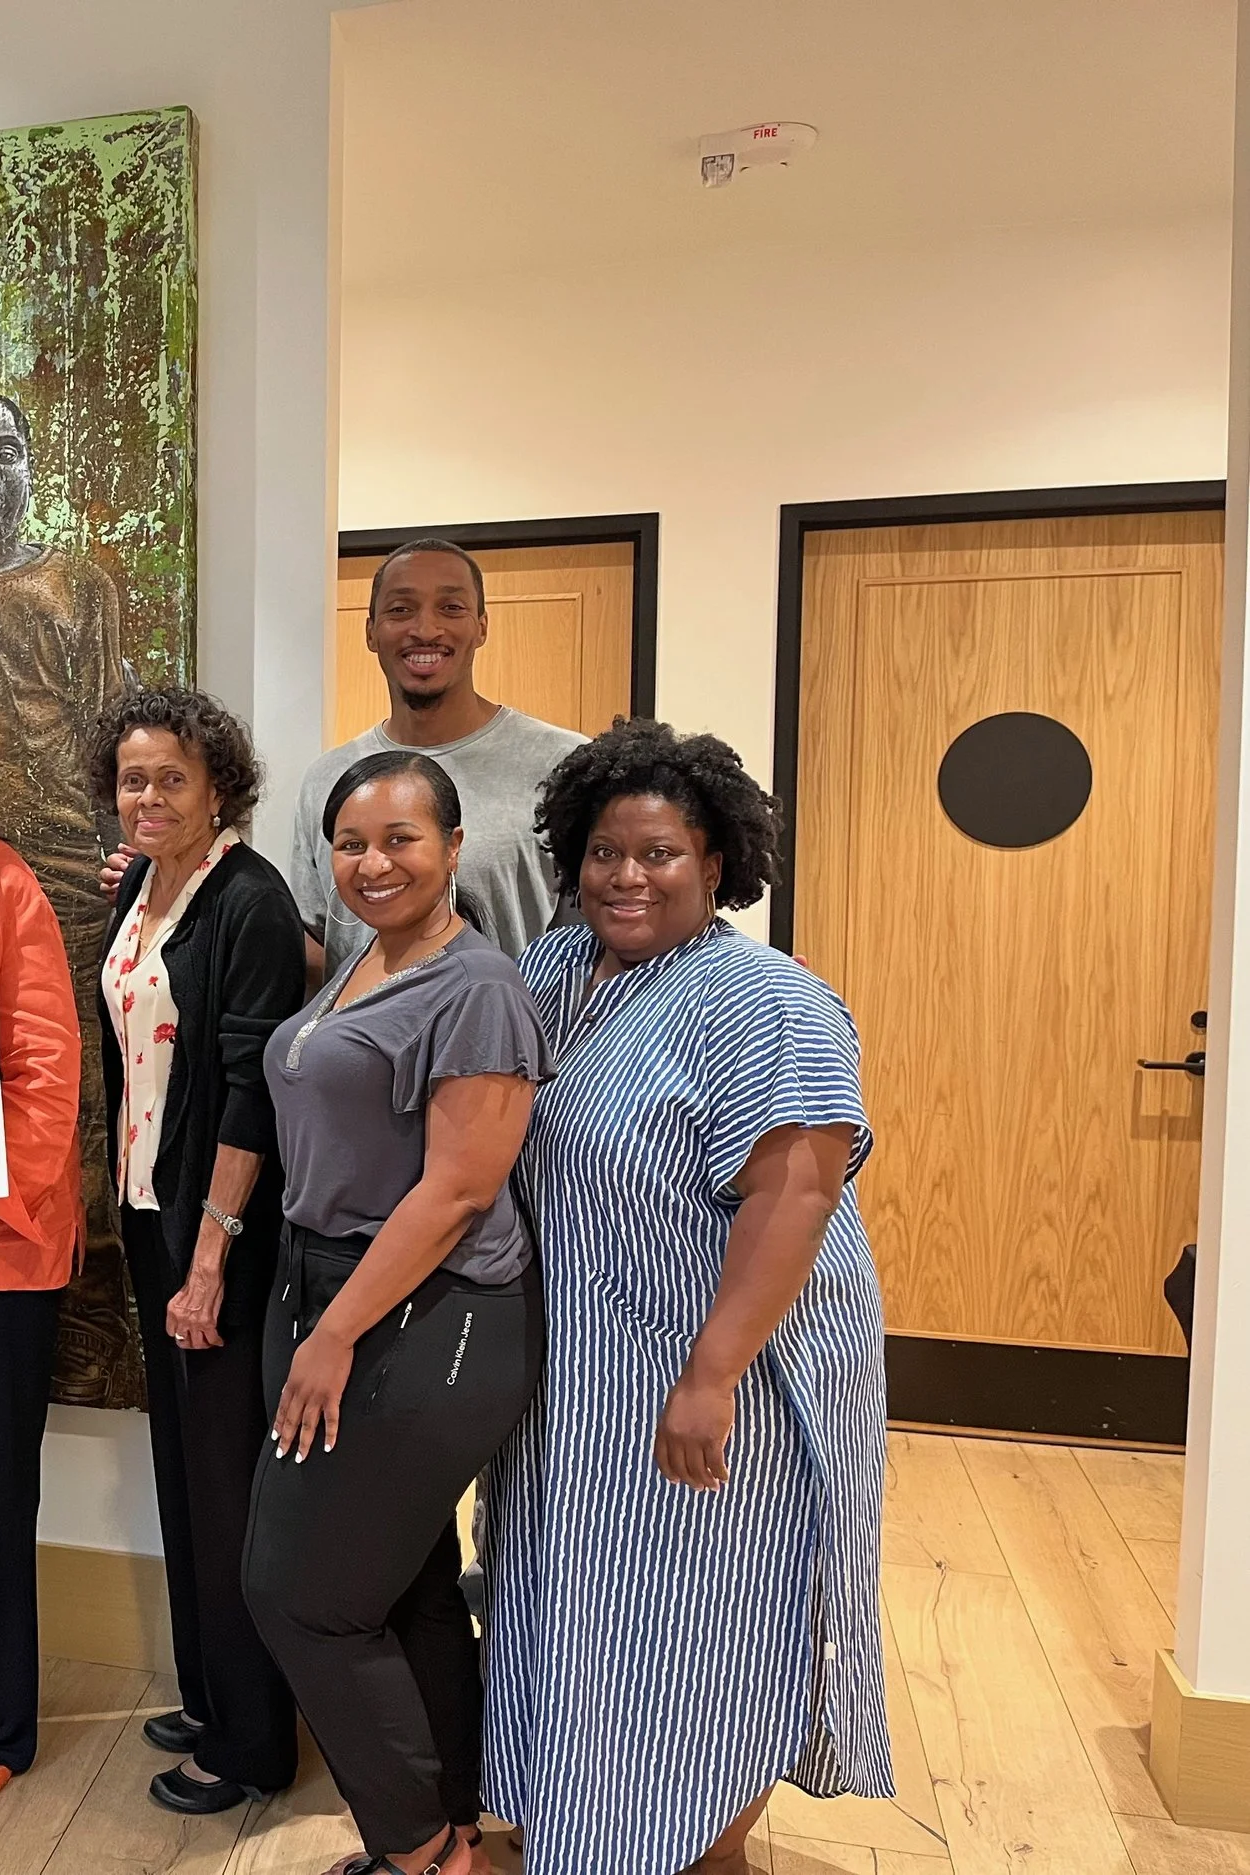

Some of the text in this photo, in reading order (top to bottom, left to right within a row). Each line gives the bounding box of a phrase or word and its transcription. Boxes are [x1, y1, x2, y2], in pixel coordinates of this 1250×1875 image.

[753, 127, 778, 139] FIRE
[446, 1312, 473, 1386] Calvin Klein Jeans
